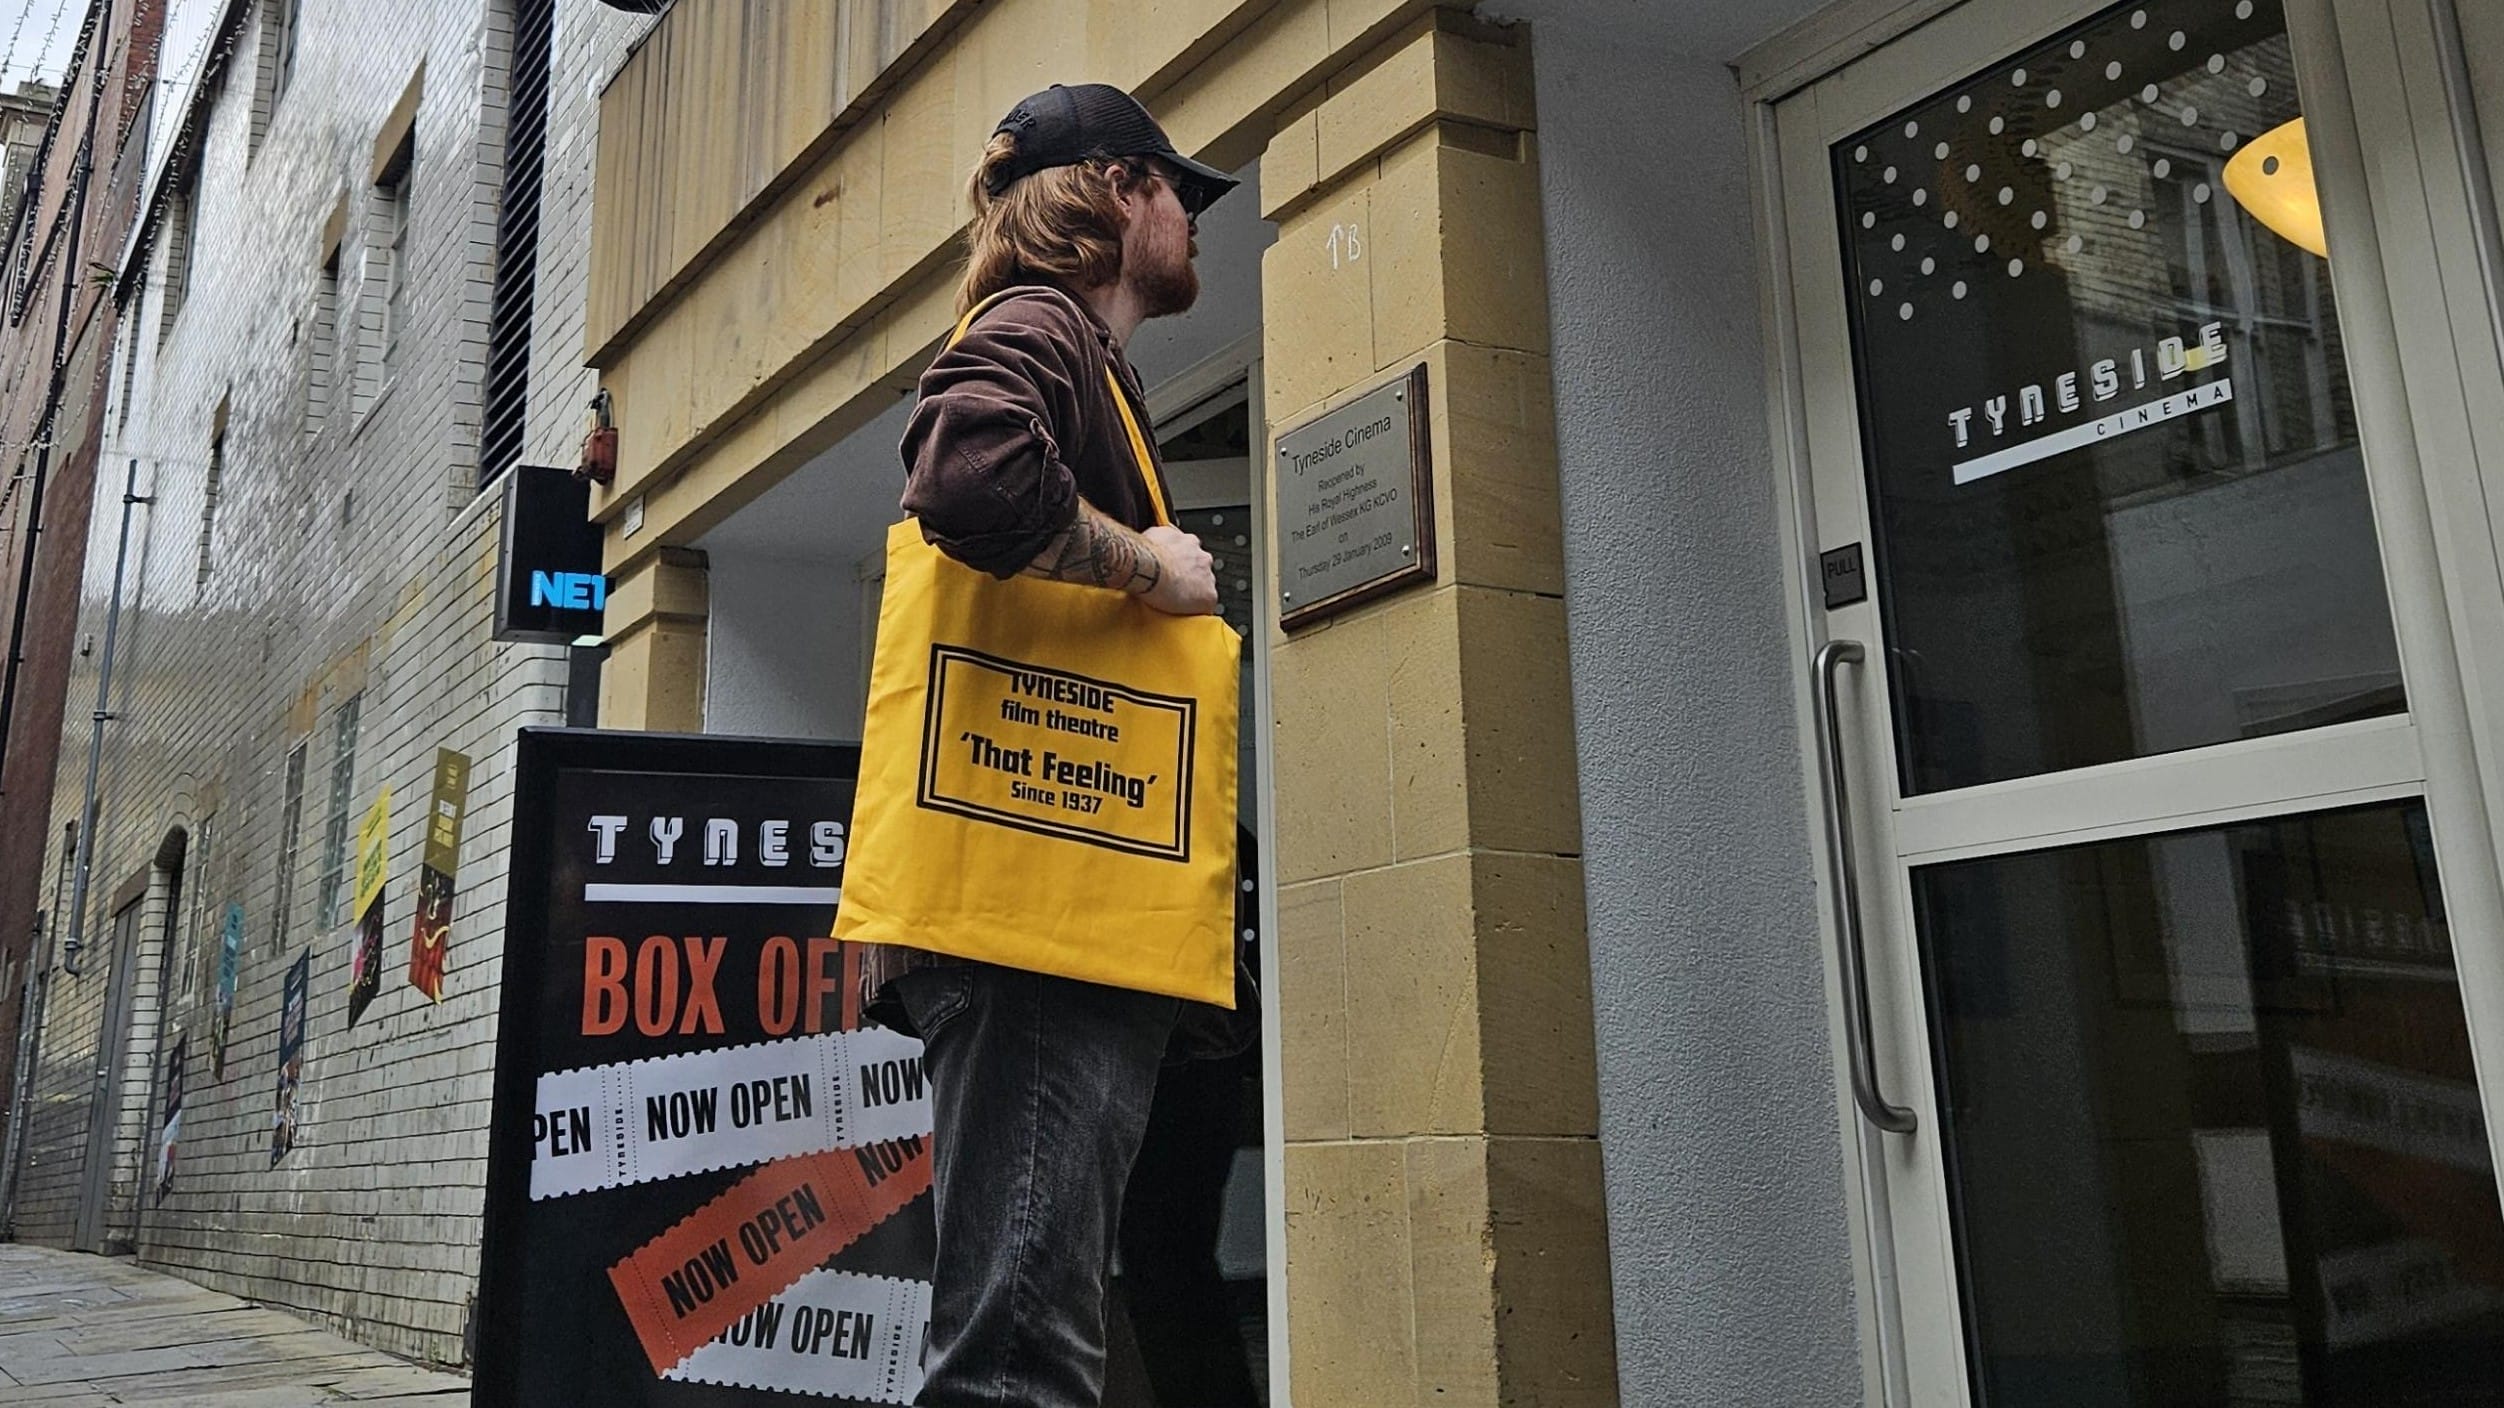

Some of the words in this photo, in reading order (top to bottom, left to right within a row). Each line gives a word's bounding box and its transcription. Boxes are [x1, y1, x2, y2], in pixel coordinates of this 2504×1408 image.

[1948, 321, 2228, 448] TYNESIDE
[2096, 385, 2224, 436] CINEMA
[1291, 437, 1342, 476] Tyneside
[1345, 416, 1391, 448] Cinema
[1308, 503, 1320, 517] His
[1321, 492, 1341, 511] Royal
[1343, 479, 1377, 502] Highness
[1318, 466, 1354, 492] Reopened
[1355, 463, 1366, 478] by
[1291, 529, 1305, 542] The
[1305, 520, 1320, 537] Earl
[1321, 516, 1329, 531] of
[1330, 508, 1359, 527] Wessex
[1360, 498, 1372, 514] KG
[1373, 488, 1398, 509] KCVO
[1338, 531, 1348, 544] on
[1299, 560, 1331, 579] Thursday
[1343, 543, 1371, 563] January
[1827, 556, 1857, 580] PULL
[1010, 672, 1115, 714] TYNESIDE
[1001, 699, 1039, 726] film
[1045, 709, 1119, 743] theatre
[1011, 780, 1055, 806] Since
[1061, 790, 1103, 814] 1937
[587, 815, 847, 868] TYNES
[581, 935, 728, 1037] BOX
[646, 1087, 718, 1142] NOW
[731, 1073, 812, 1129] OPEN
[832, 1076, 845, 1141] TYNESIDE
[860, 1057, 924, 1108] NOW
[614, 1108, 627, 1177] TYNESIDE
[661, 1238, 738, 1319] NOW
[739, 1183, 826, 1267] OPEN
[791, 1305, 874, 1360] OPEN
[886, 1325, 902, 1394] TYNESIDE
